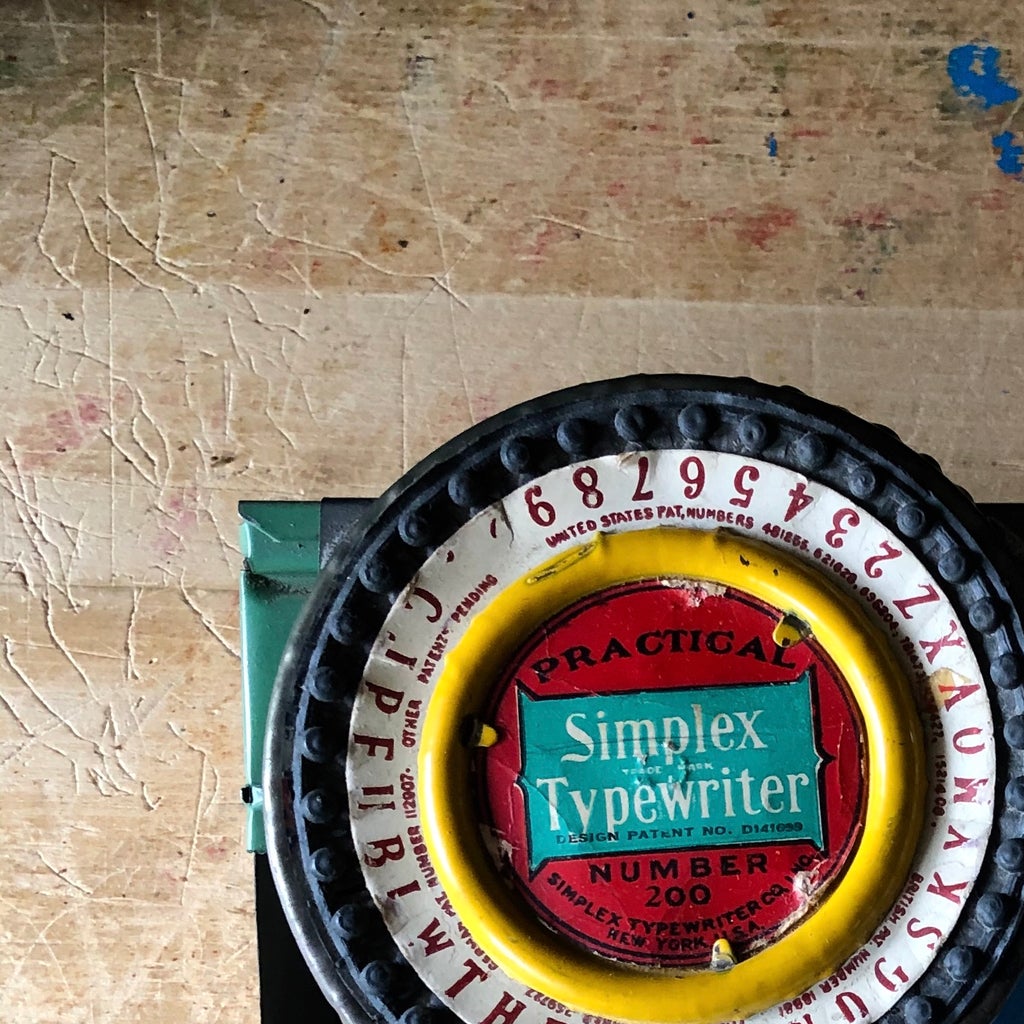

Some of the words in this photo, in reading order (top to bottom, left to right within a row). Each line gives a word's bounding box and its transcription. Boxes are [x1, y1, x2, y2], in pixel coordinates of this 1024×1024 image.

[572, 465, 604, 509] 8
[729, 465, 760, 509] 5
[784, 482, 814, 523] 4
[545, 519, 598, 548] UNITED
[599, 506, 654, 528] STATES
[686, 507, 754, 529] NUMBERS
[825, 507, 860, 549] 3
[864, 540, 902, 579] 2
[401, 699, 422, 748] OTHER
[450, 574, 498, 624] PENDING
[530, 629, 798, 684] PRACTICAL
[560, 703, 769, 766] Simplex
[536, 767, 811, 842] Typewriter
[556, 832, 620, 845] DESIGN
[627, 827, 695, 840] PATENT
[702, 825, 733, 836] NO.
[407, 825, 440, 888] NUMBER
[589, 852, 768, 884] NUMBER
[546, 871, 623, 928] SIMPLEX
[628, 900, 762, 938] TYPEWRITER
[644, 884, 712, 908] 200
[889, 872, 925, 925] BRITISH
[926, 872, 969, 905] K
[607, 926, 648, 948] NEW
[906, 917, 943, 950] S
[444, 958, 488, 1000] T
